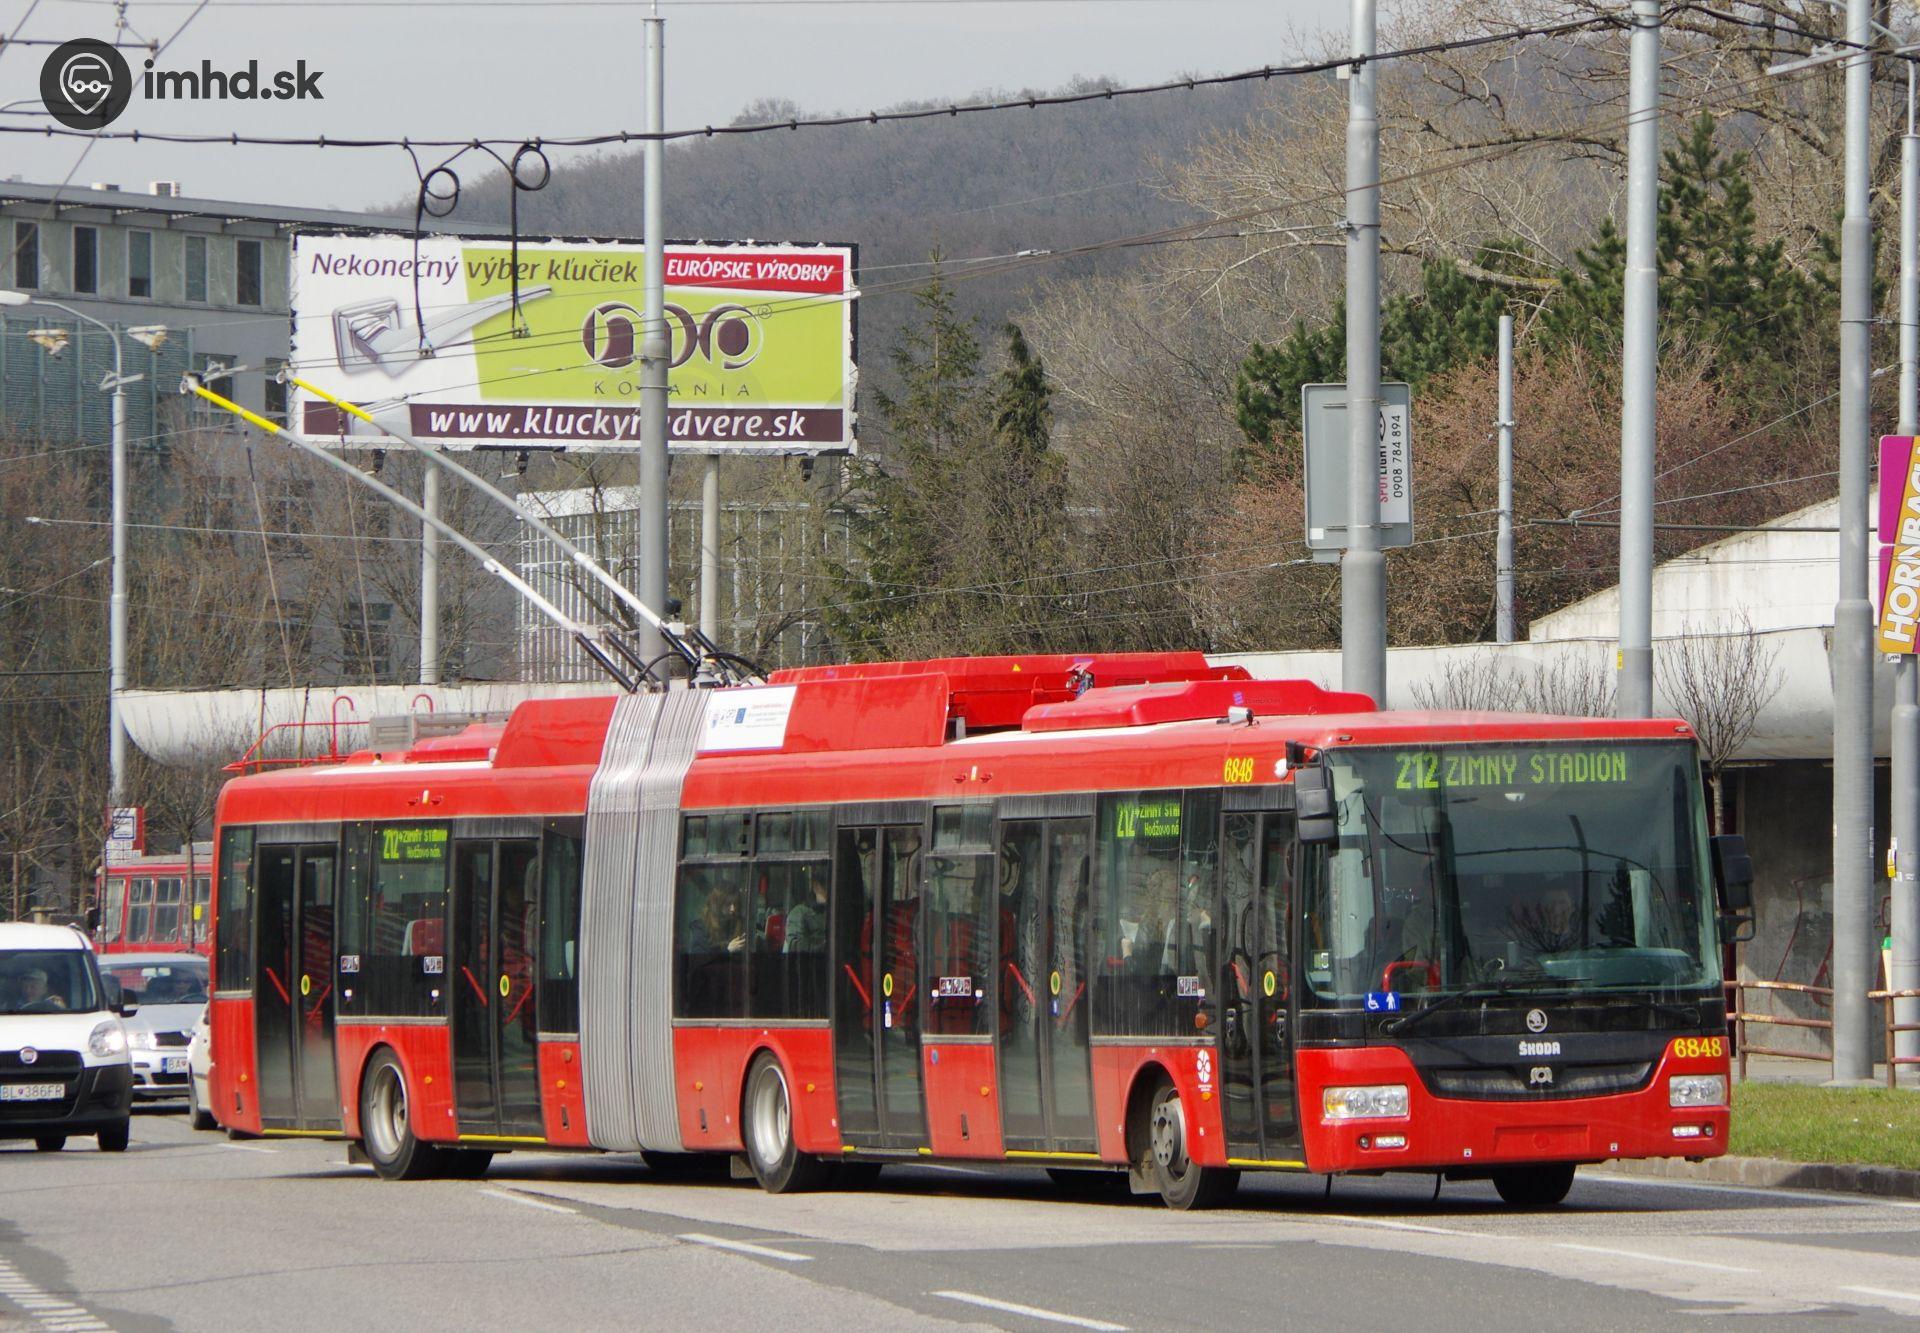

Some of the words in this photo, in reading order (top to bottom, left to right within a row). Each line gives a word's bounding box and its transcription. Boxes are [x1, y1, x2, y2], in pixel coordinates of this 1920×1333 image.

[311, 253, 459, 286] Nekonečný
[467, 256, 541, 287] výber
[547, 258, 638, 283] kľučiek
[667, 257, 753, 280] EURÓPSKE
[756, 259, 834, 282] VÝROBKY
[594, 381, 750, 396] KOANIA
[430, 408, 805, 441] www.kluckyndvere.sk
[1391, 415, 1401, 437] 894
[1392, 442, 1402, 462] 784
[1393, 468, 1403, 498] 0908
[1884, 446, 1920, 642] HORNB
[1224, 758, 1254, 783] 6848
[1396, 752, 1439, 789] 212
[1519, 1040, 1560, 1056] ŠKODA
[1674, 1038, 1722, 1058] 6848
